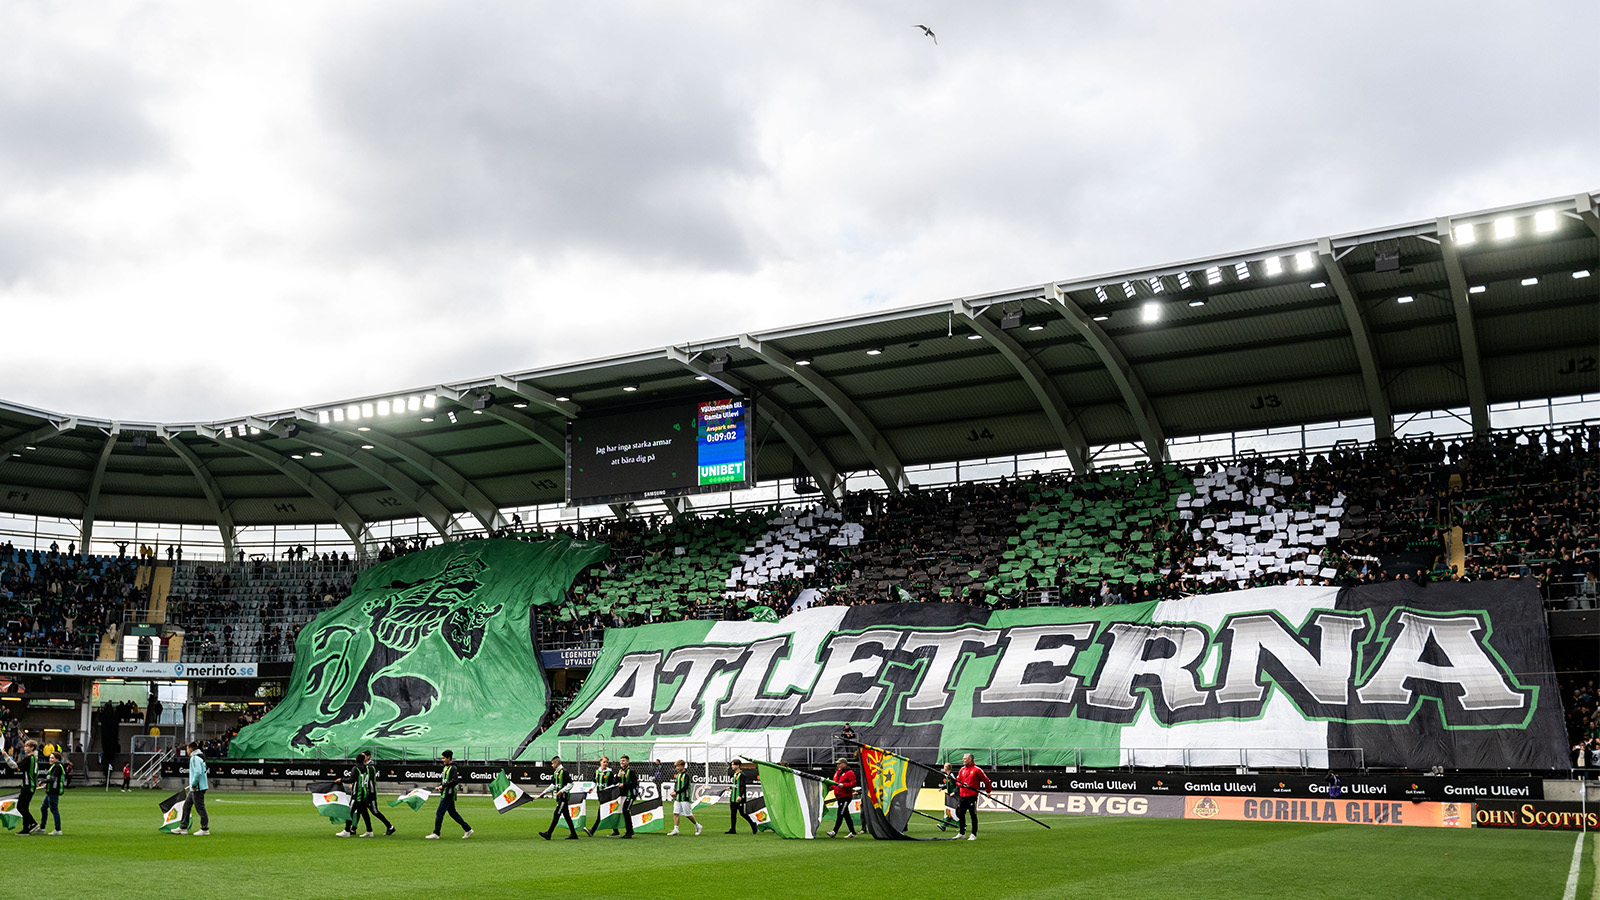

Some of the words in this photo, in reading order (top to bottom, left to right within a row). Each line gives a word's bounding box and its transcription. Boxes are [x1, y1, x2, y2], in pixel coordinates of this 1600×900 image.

[1250, 394, 1281, 409] J3
[704, 412, 722, 420] Gamla
[706, 424, 726, 432] Avspark
[707, 431, 736, 442] 0:09:02
[968, 427, 994, 441] J4
[596, 446, 605, 455] Jag
[618, 444, 631, 452] inga
[632, 441, 651, 449] starka
[652, 439, 672, 447] armar
[636, 455, 646, 463] dig
[647, 453, 655, 462] på
[701, 463, 742, 477] UNIBET
[531, 479, 557, 490] H3
[93, 664, 104, 672] vill
[117, 665, 137, 673] veta?
[187, 664, 254, 676] merinfo.se
[562, 611, 1527, 731] ATLETERNA
[426, 771, 443, 779] Ullev
[1000, 780, 1027, 788] Ullevi
[1070, 781, 1104, 789] Gamla
[1106, 781, 1136, 790] Ullevi
[1184, 782, 1220, 791] Gamla
[1224, 782, 1256, 792] Ullevi
[1309, 784, 1348, 793] Gaa
[1352, 784, 1387, 794] Ullevi
[1444, 785, 1487, 795] Gamla
[1491, 785, 1529, 796] Ullevi
[1019, 794, 1148, 814] XL-BYGG
[1244, 799, 1338, 822] GORILLA
[1346, 801, 1402, 824] GLUE
[1476, 809, 1517, 826] OHN
